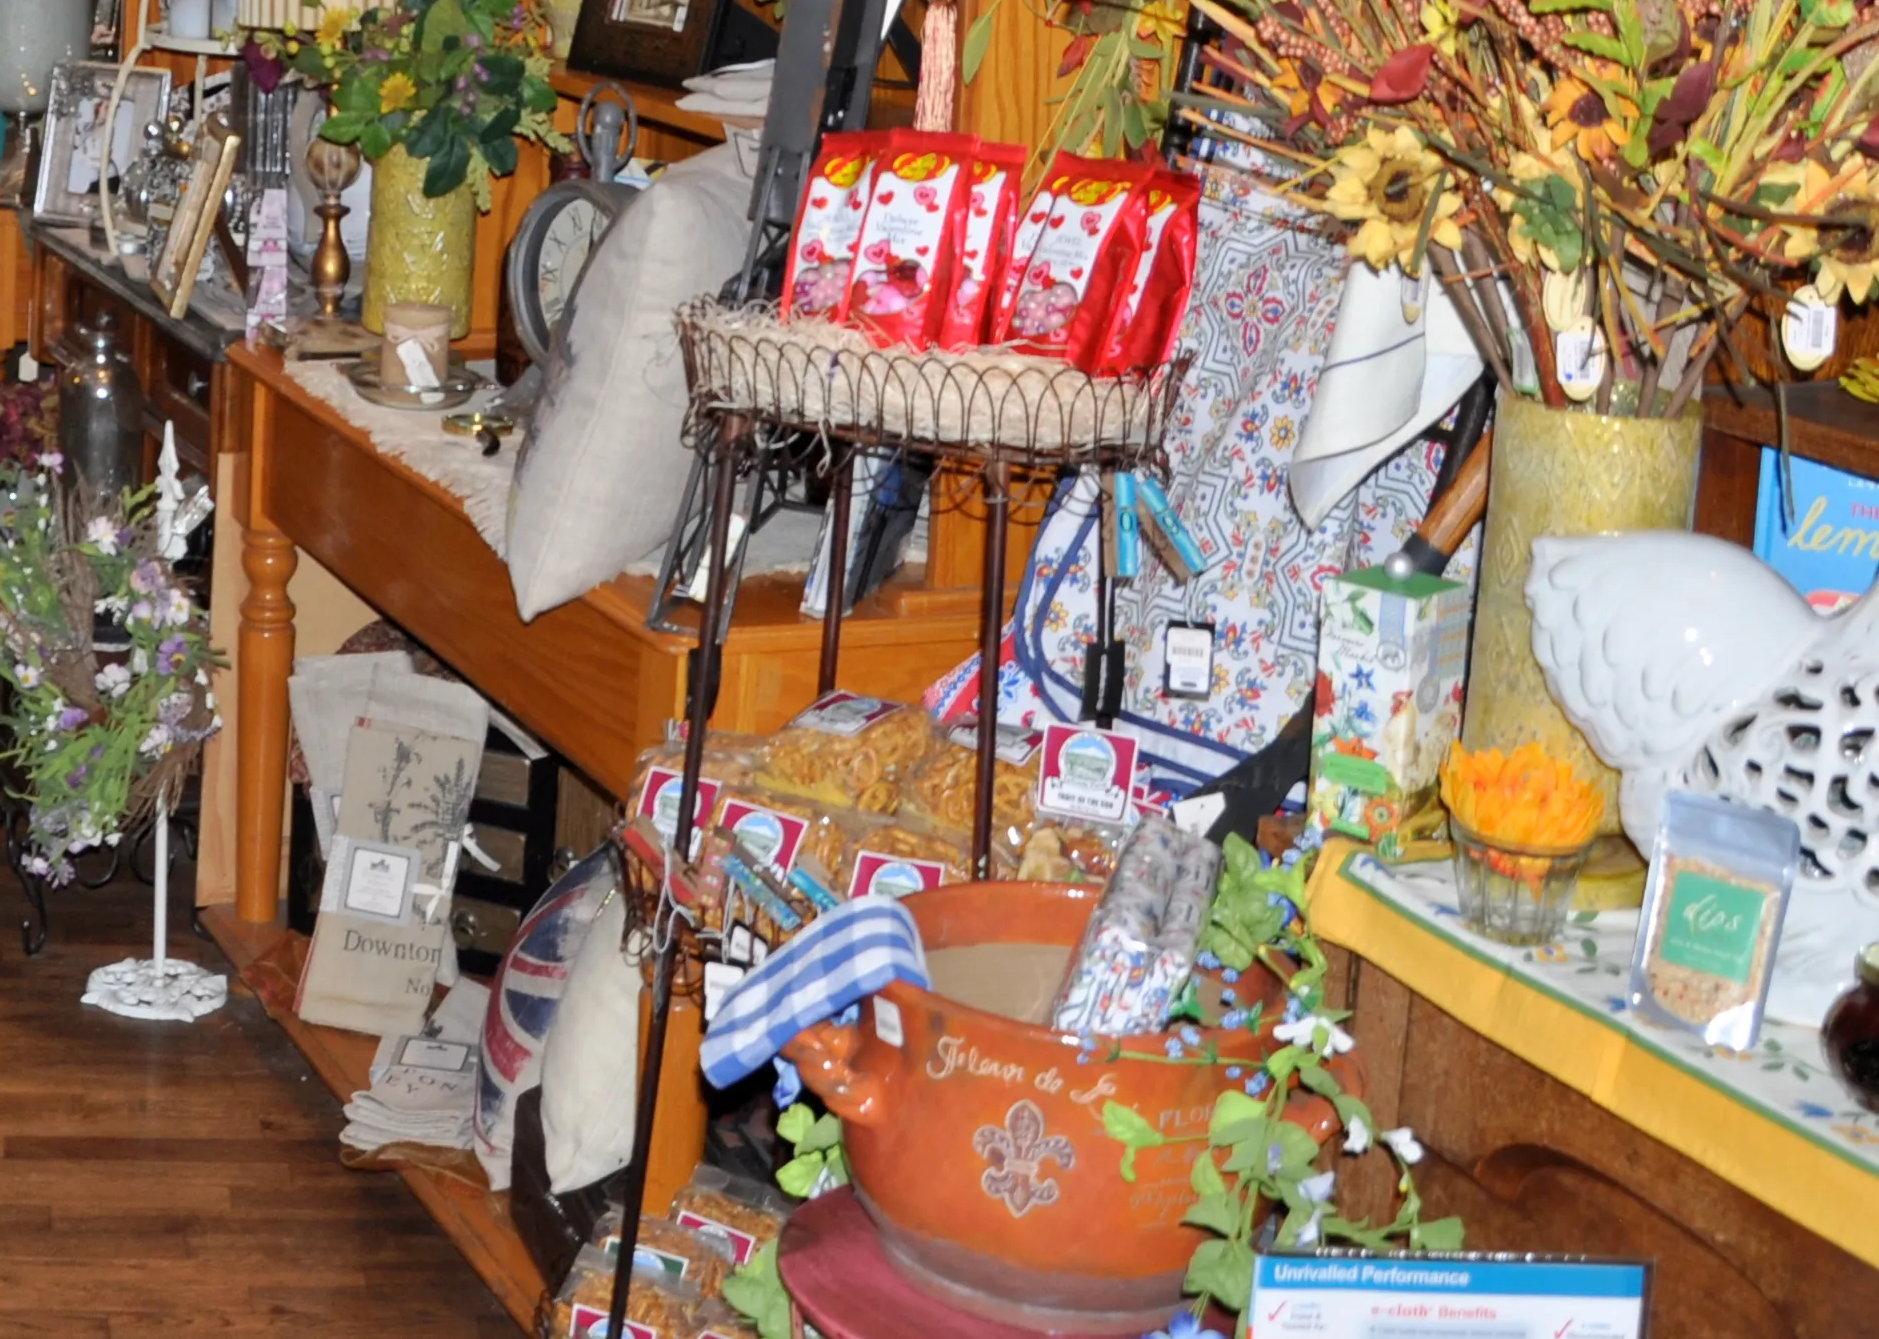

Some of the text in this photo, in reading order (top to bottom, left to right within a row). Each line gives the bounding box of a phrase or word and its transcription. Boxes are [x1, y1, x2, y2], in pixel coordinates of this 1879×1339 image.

[343, 929, 442, 964] Downton
[1274, 1262, 1470, 1287] Unrivalled Performance
[1438, 1305, 1497, 1320] Benefits
